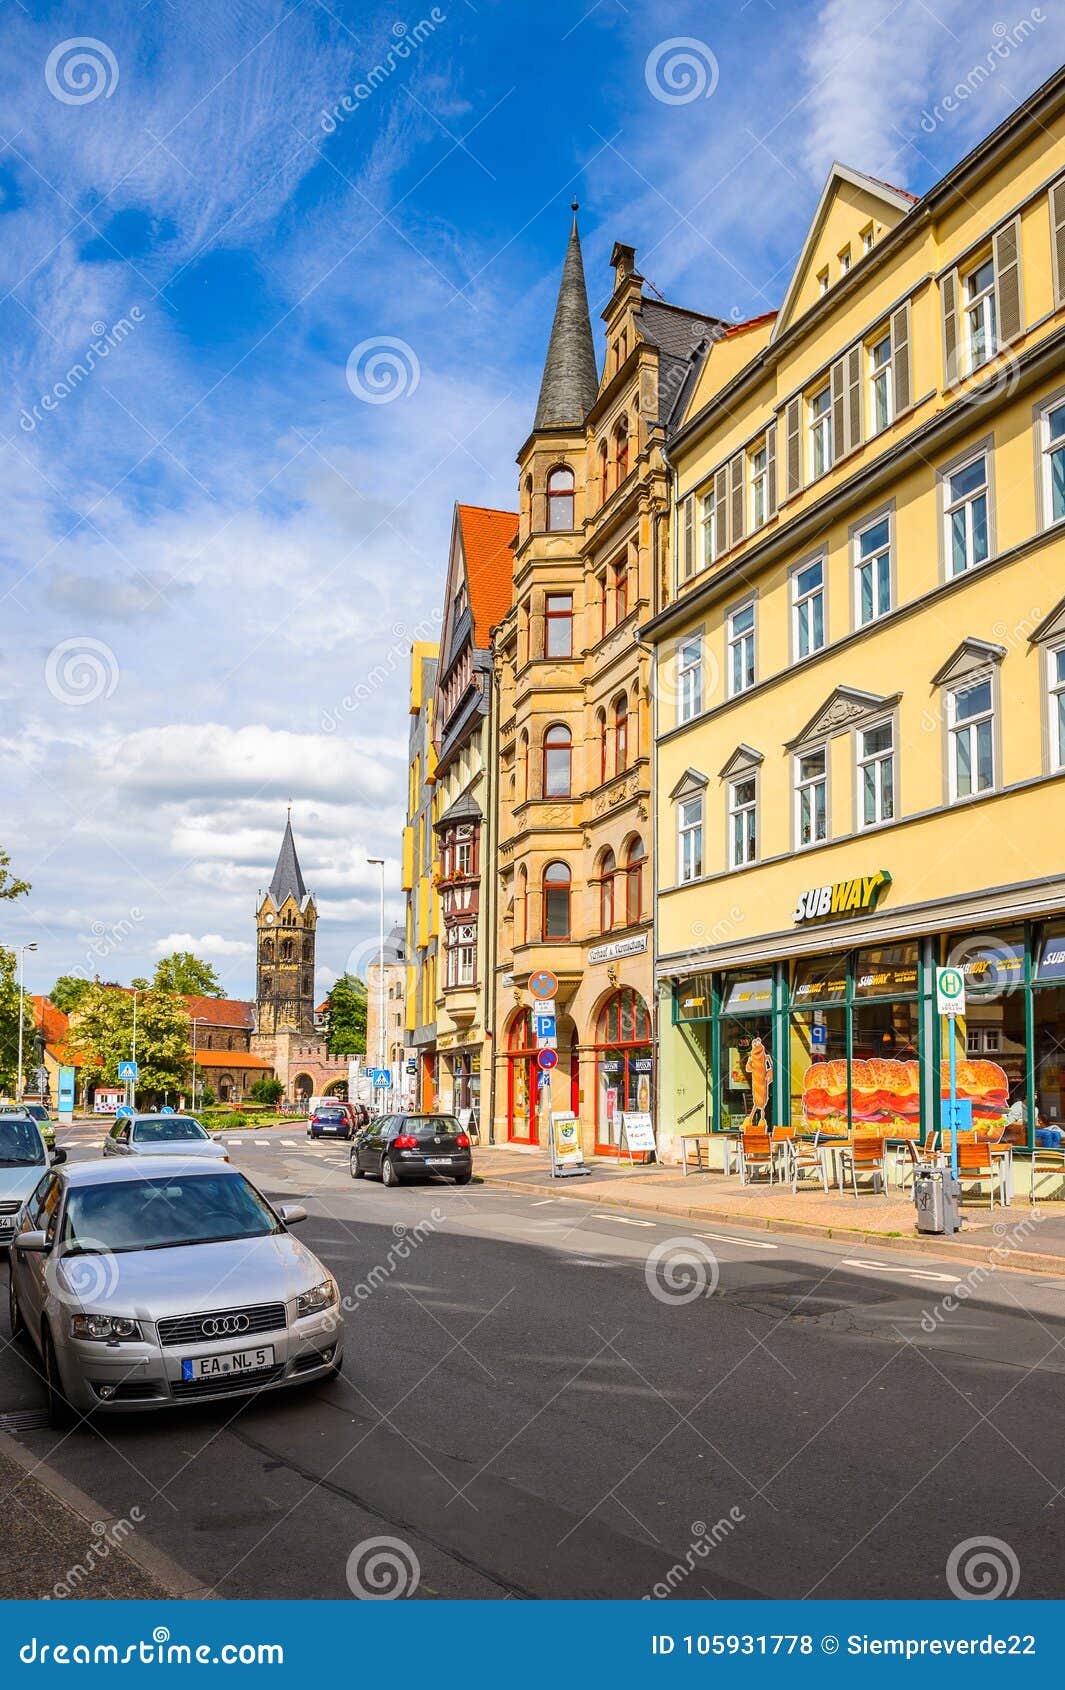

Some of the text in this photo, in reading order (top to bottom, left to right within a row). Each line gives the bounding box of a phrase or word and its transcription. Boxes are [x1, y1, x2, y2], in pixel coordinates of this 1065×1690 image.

[792, 870, 890, 921] SUBWAY
[1043, 951, 1065, 965] SUB
[858, 972, 891, 988] SUBWAY
[945, 975, 956, 992] H
[541, 1018, 551, 1035] P
[200, 1358, 220, 1375] EA
[232, 1353, 251, 1369] NL
[256, 1350, 265, 1365] 5
